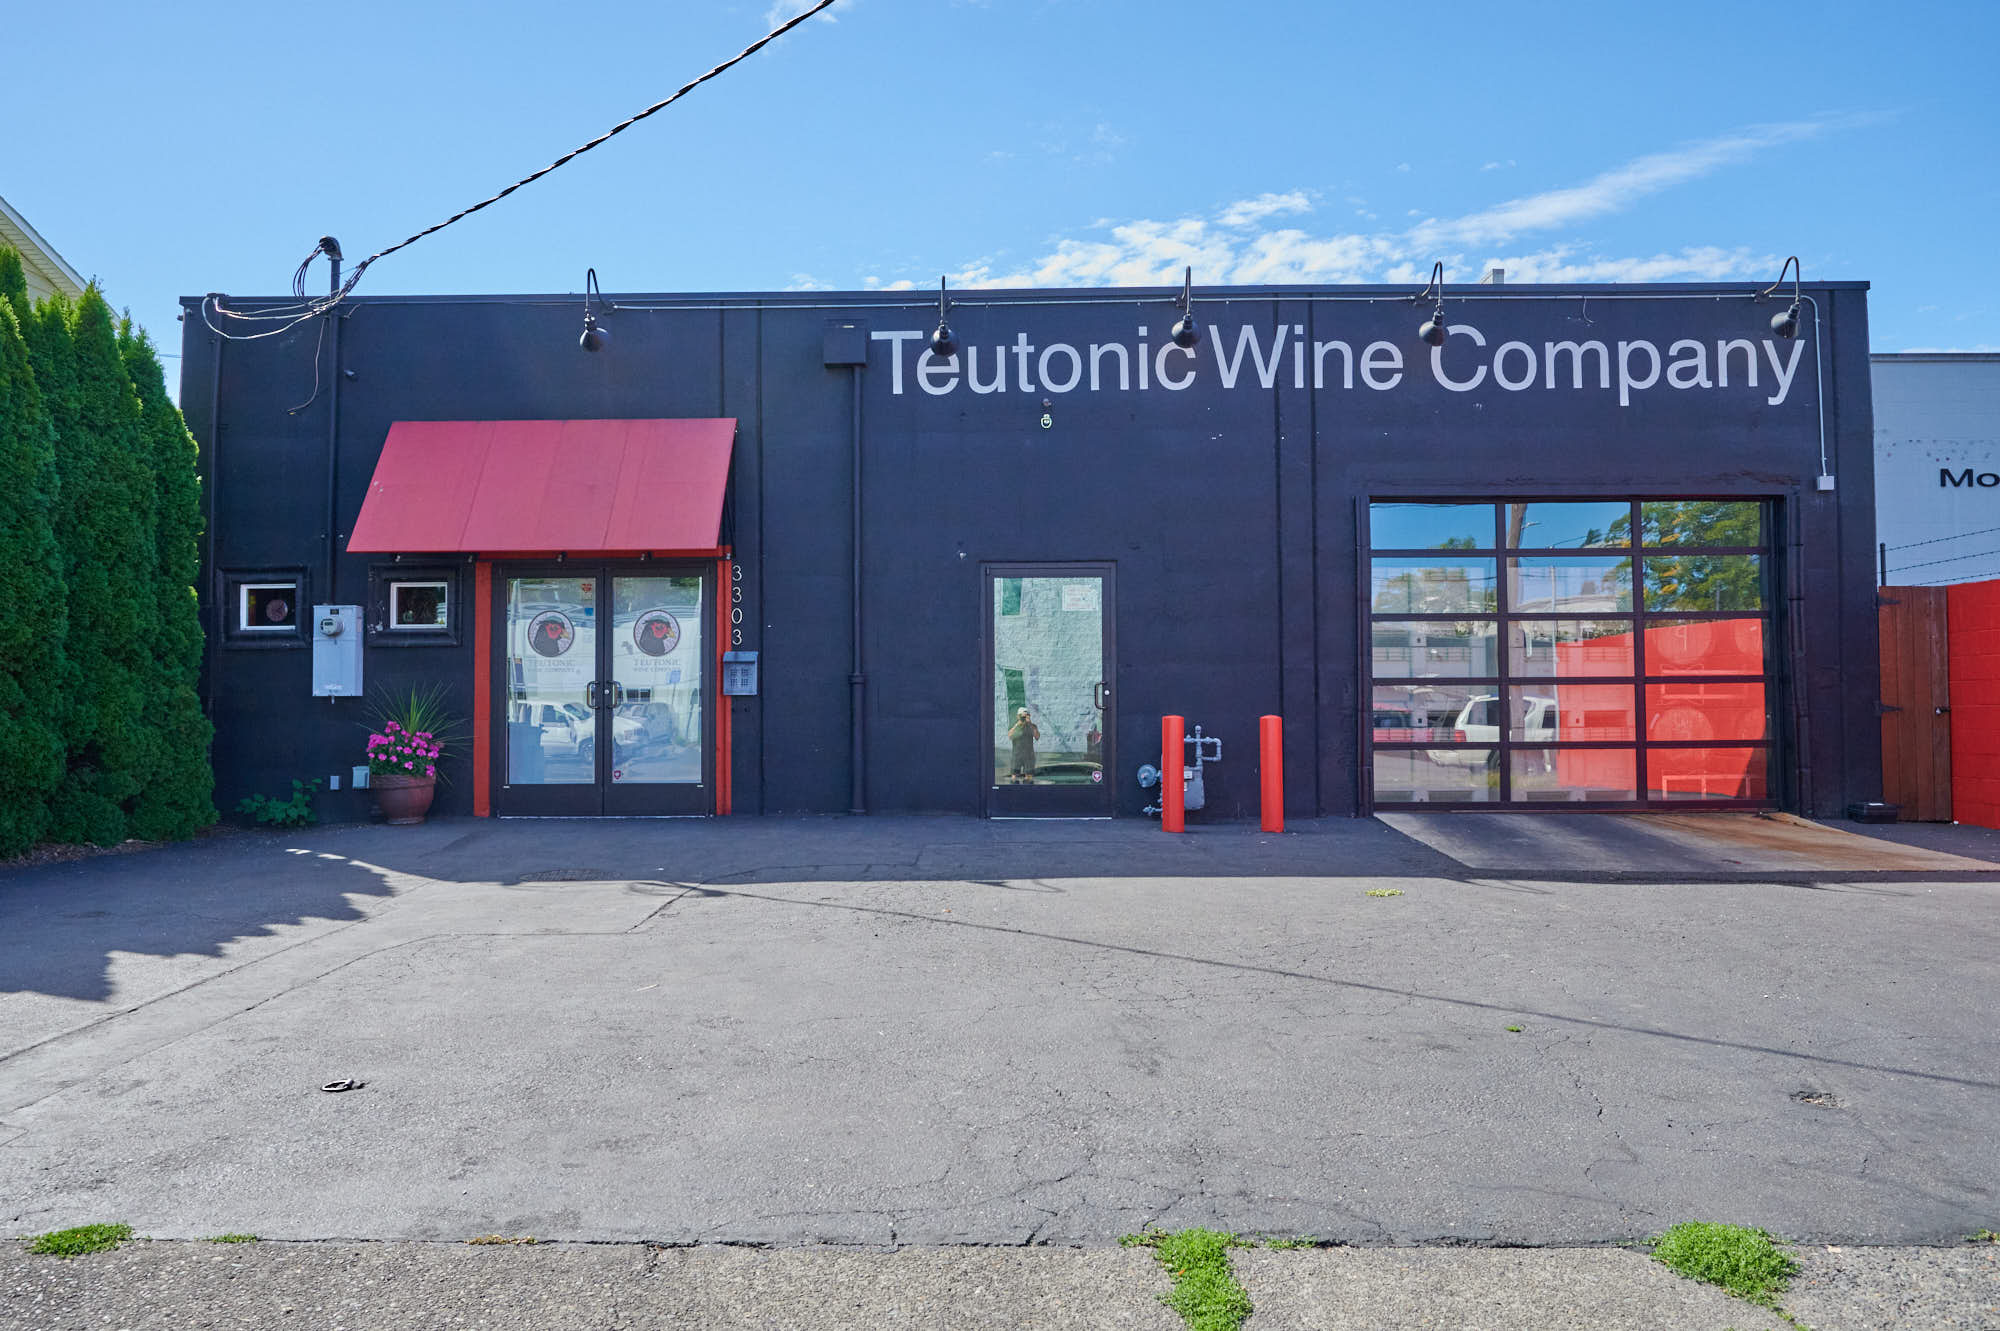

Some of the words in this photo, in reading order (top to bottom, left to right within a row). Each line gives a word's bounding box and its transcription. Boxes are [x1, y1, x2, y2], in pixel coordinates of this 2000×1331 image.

[871, 326, 1196, 395] Teutonic
[1209, 325, 1403, 390] Wine
[1430, 324, 1806, 406] Company
[732, 565, 743, 645] 3303
